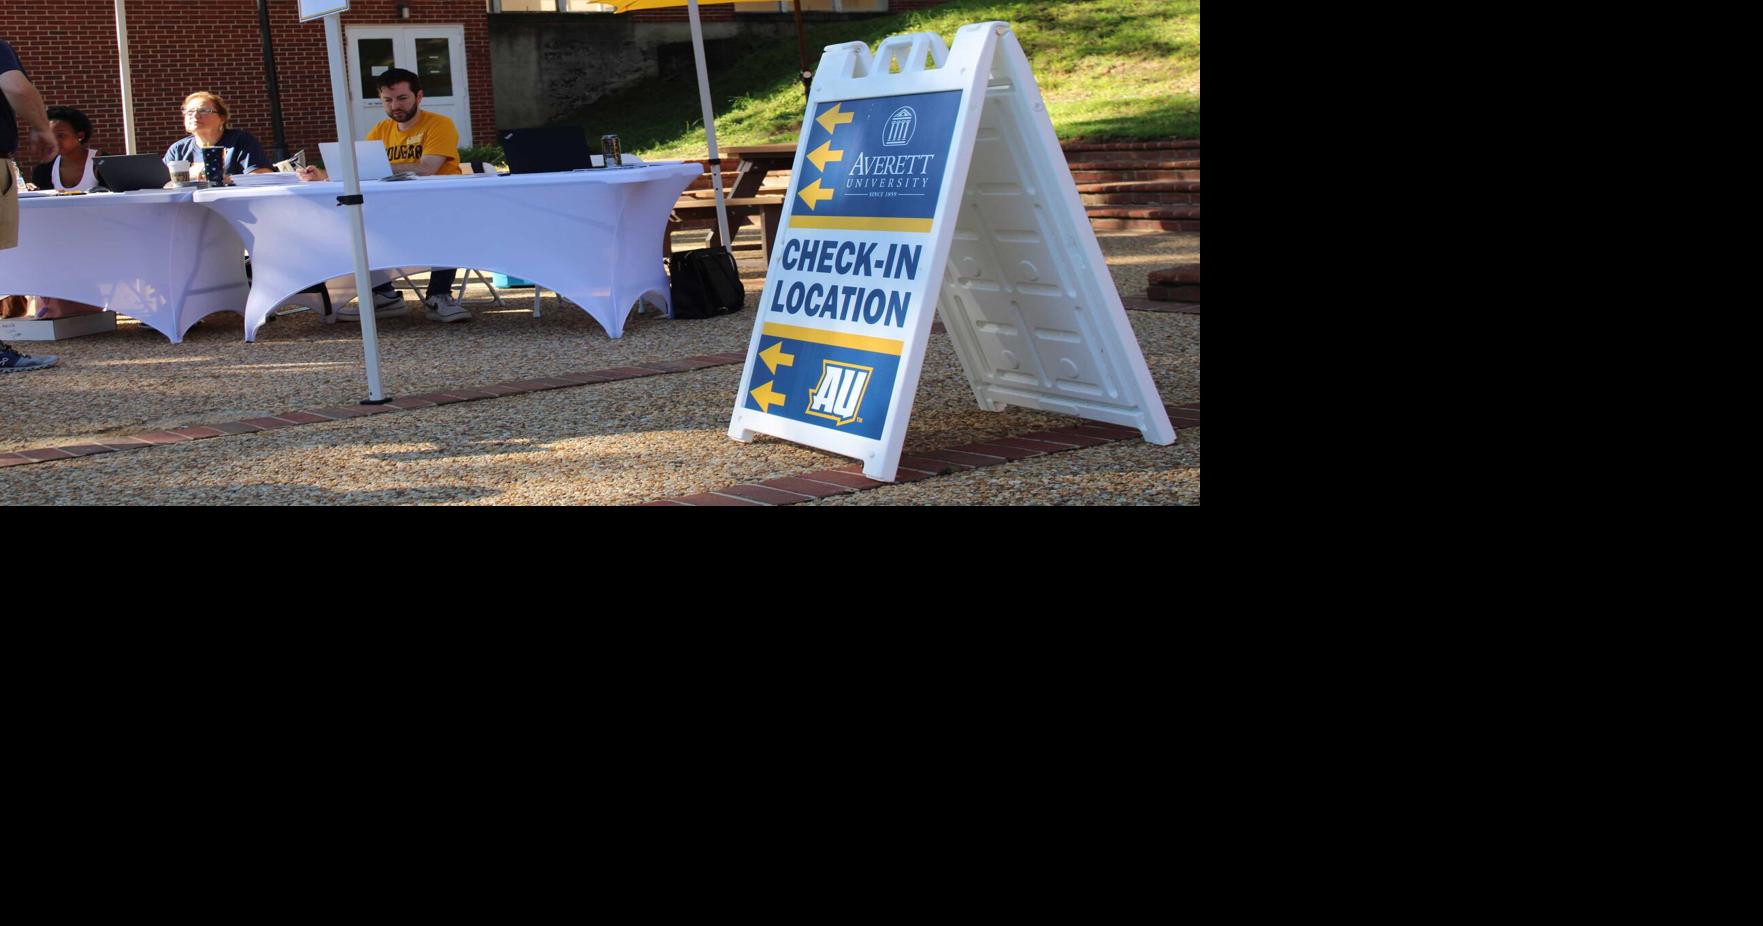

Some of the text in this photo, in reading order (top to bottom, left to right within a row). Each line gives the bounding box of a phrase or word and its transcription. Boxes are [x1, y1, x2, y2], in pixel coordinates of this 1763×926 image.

[385, 144, 423, 161] OUGAR
[848, 151, 935, 176] AVERETT
[846, 177, 929, 188] UNIVERSITY
[782, 238, 923, 281] CHECK-IN
[770, 280, 912, 329] LOCATION
[810, 365, 868, 419] AU
